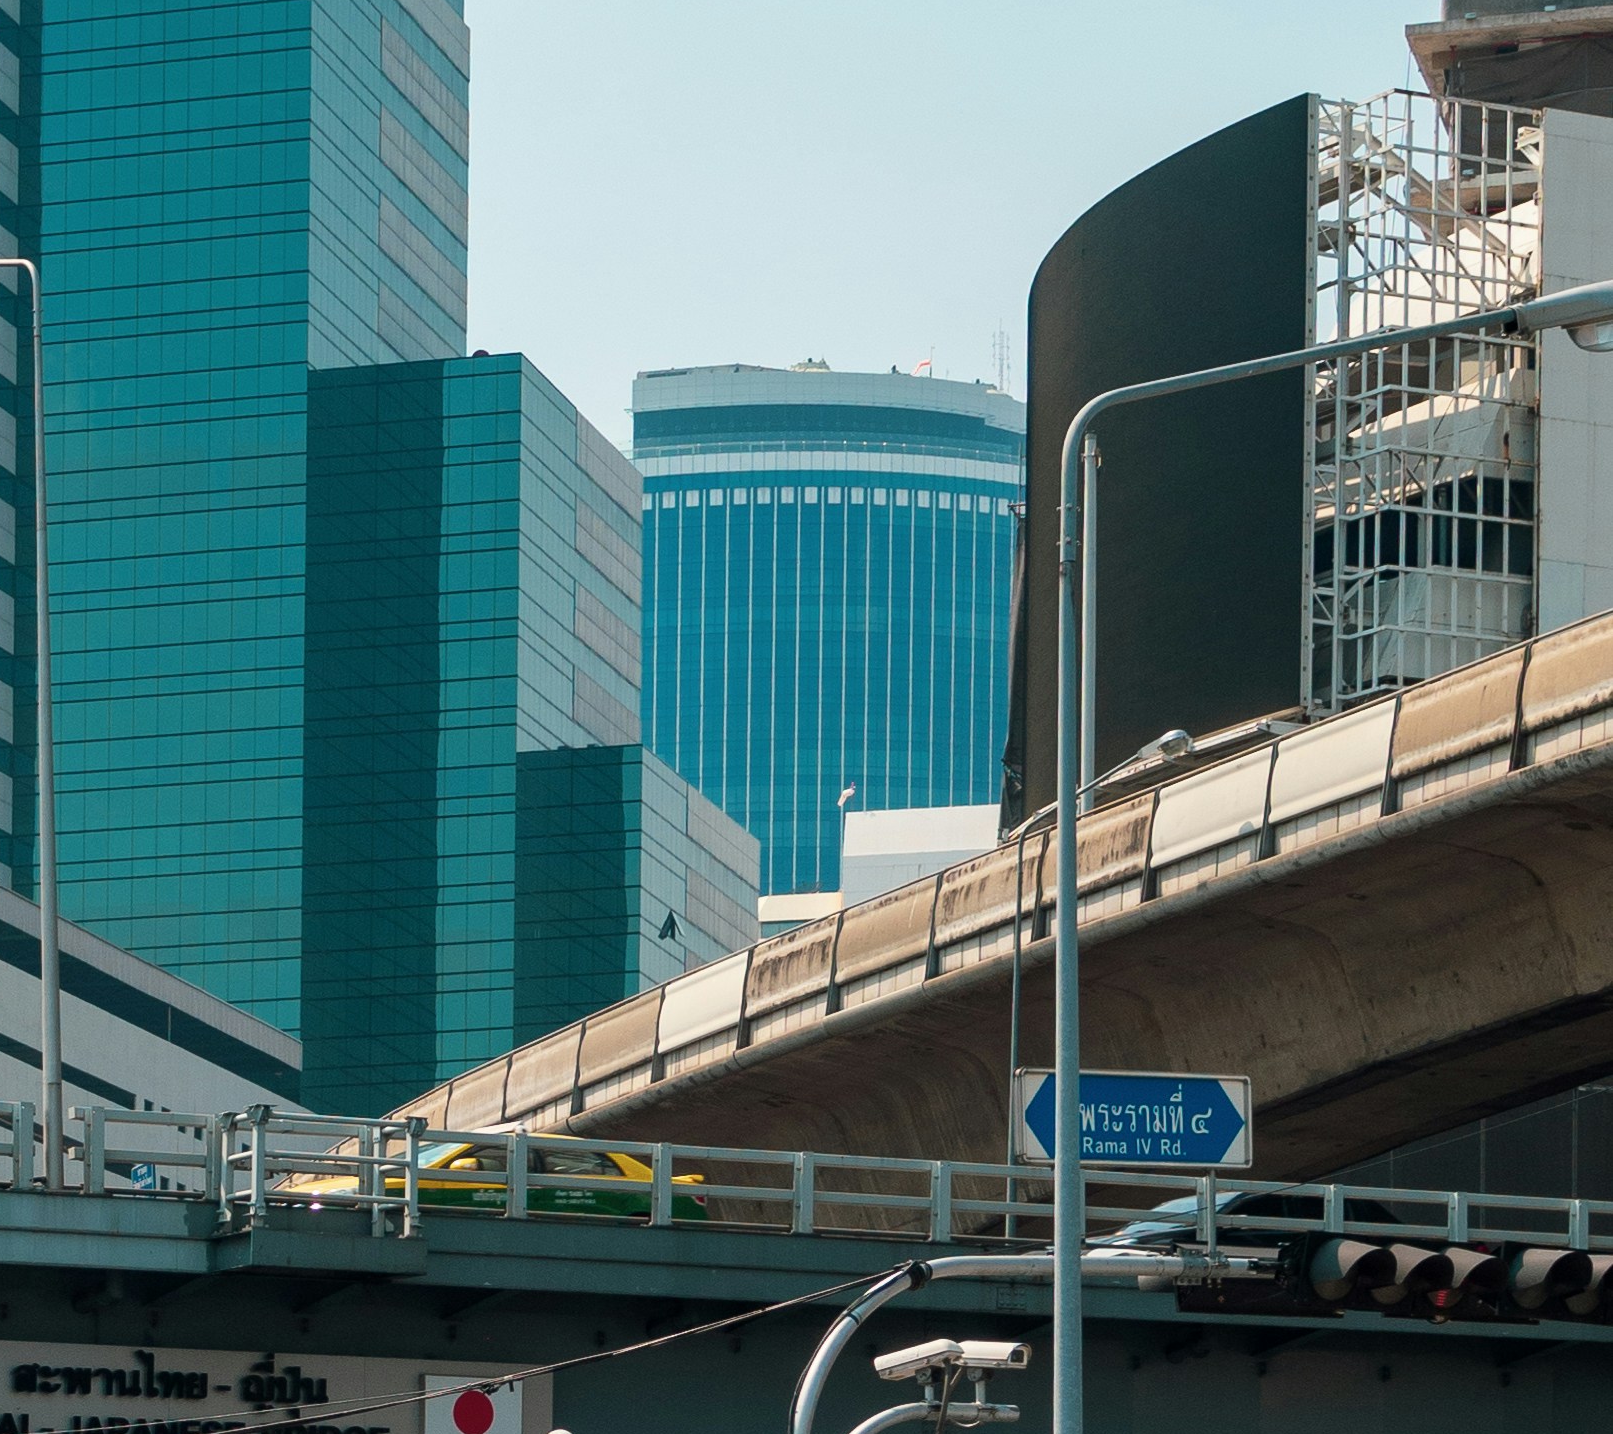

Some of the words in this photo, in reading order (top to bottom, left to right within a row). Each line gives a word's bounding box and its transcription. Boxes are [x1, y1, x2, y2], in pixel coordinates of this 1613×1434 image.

[1079, 1084, 1184, 1134] พระรามที่
[1191, 1107, 1213, 1134] ๔
[1082, 1137, 1127, 1155] Rama
[1136, 1138, 1152, 1156] IV
[1160, 1139, 1187, 1156] Rd.
